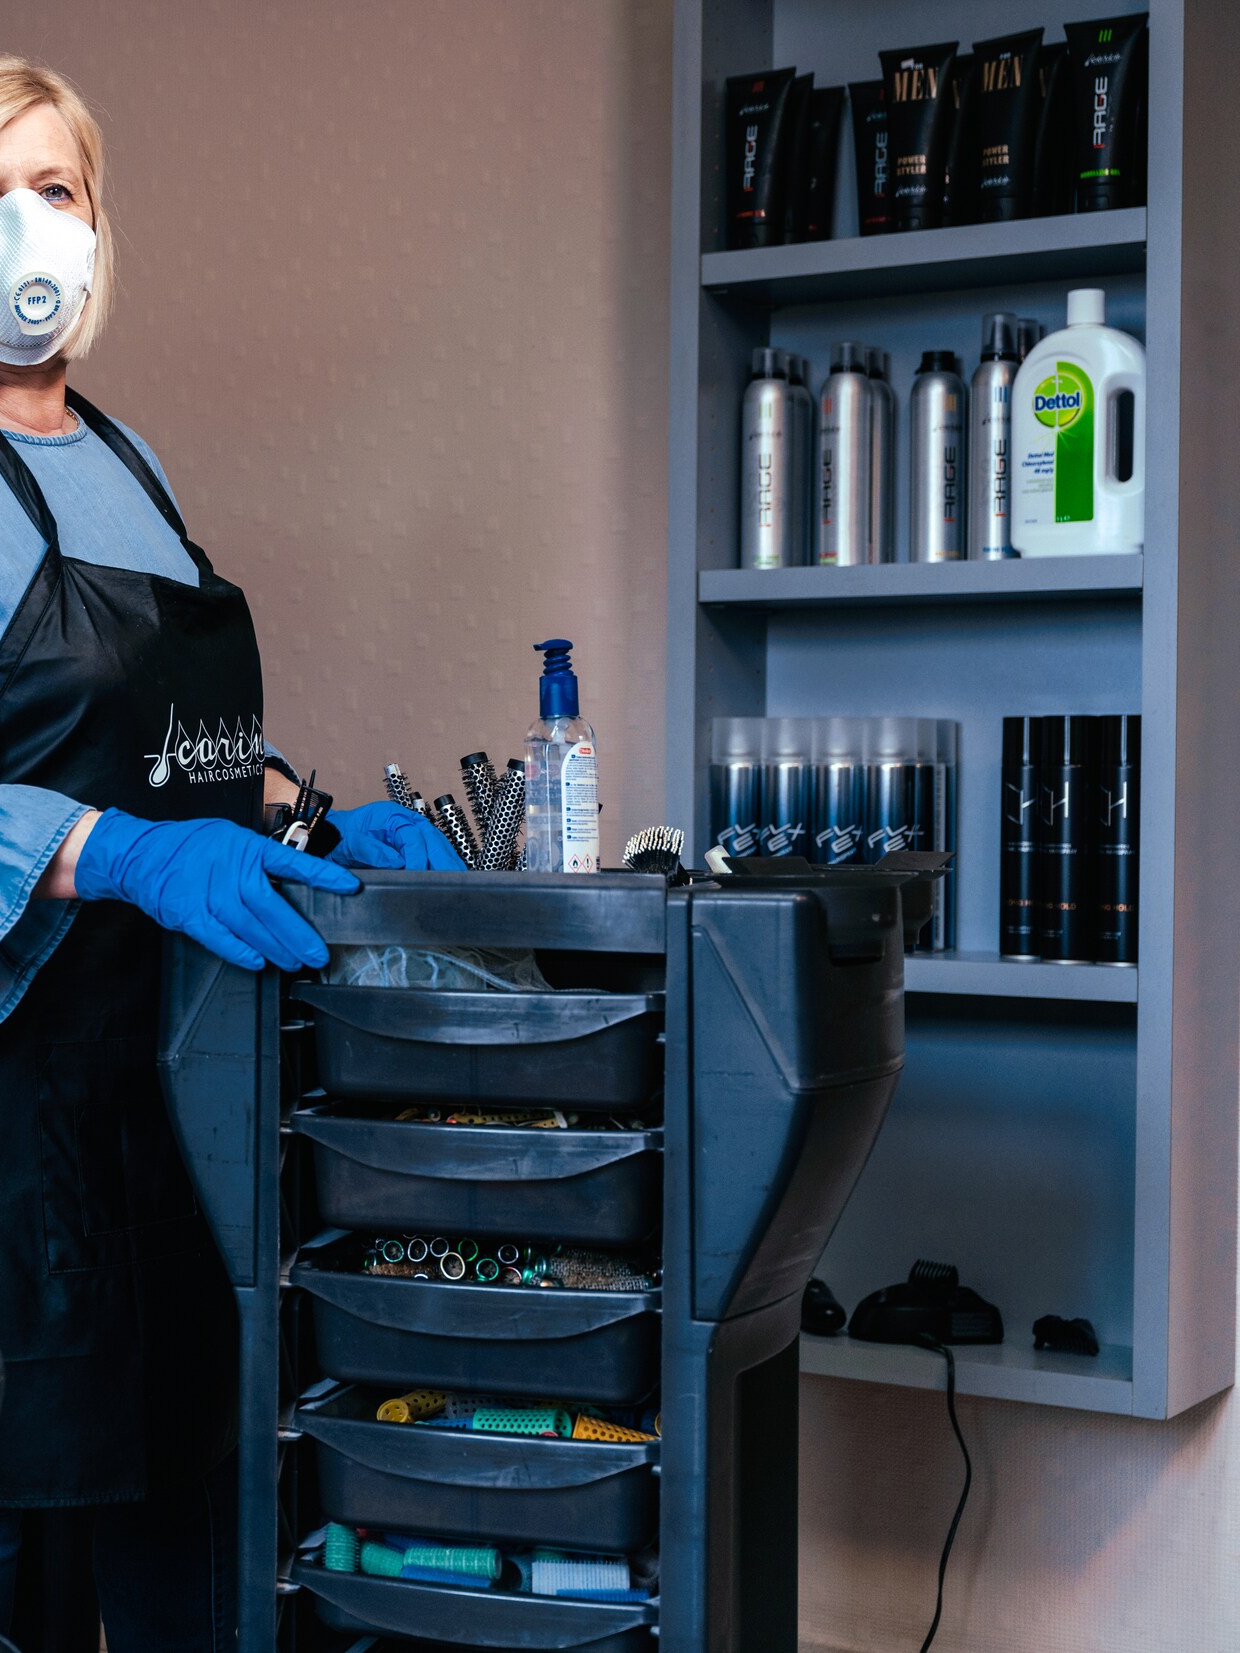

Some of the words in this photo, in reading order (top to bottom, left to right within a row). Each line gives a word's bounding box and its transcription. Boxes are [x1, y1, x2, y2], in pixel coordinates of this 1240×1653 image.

[892, 66, 939, 103] MEN
[982, 55, 1024, 92] MEN
[28, 296, 47, 305] FFP2
[1034, 391, 1081, 412] Dettol
[178, 718, 264, 767] carin
[188, 763, 264, 784] HAIRCOSMETICS
